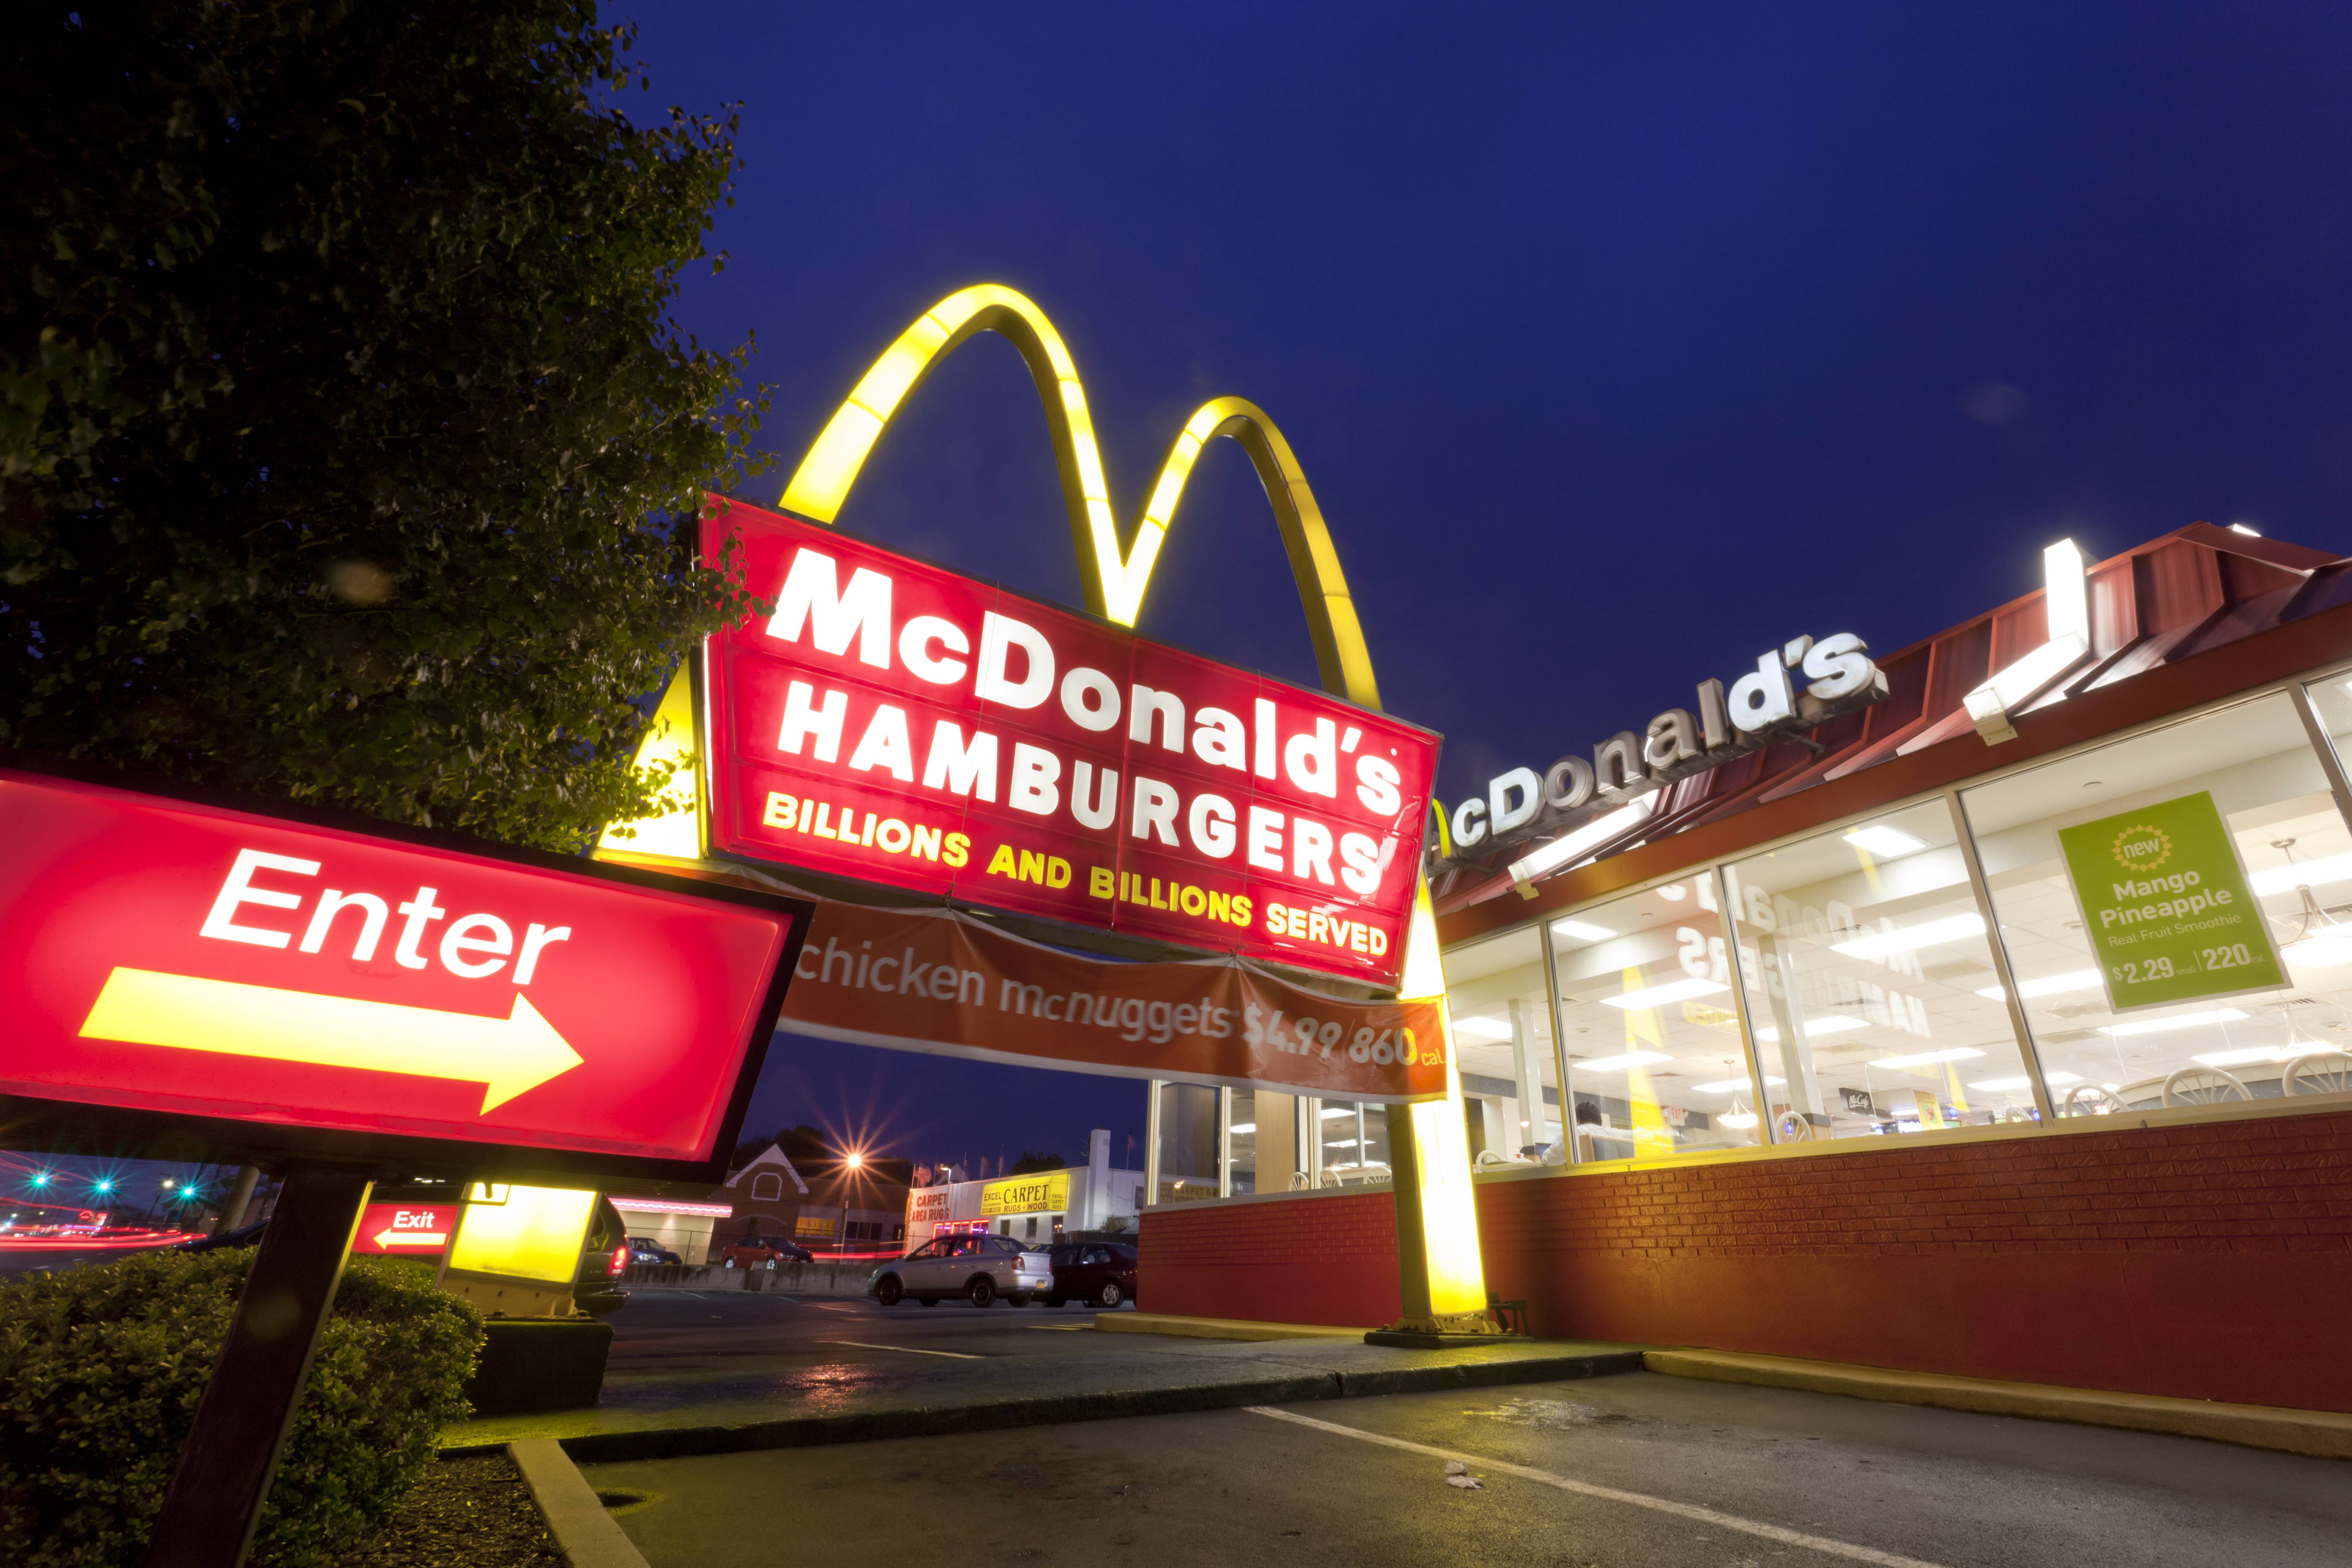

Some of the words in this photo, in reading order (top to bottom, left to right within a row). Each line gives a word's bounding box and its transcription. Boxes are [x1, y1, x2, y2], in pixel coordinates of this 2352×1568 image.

[765, 547, 1401, 817] McDonald's
[1432, 633, 1883, 859] cDonald's
[778, 681, 1381, 895] HAMBURGERS
[2123, 838, 2159, 859] new
[763, 791, 971, 868] BILLIONS
[987, 843, 1072, 890] AND
[1090, 865, 1253, 927] BILLIONS
[1267, 903, 1387, 956] SERVED
[2113, 871, 2200, 901] Mango
[199, 848, 572, 985] Enter
[2100, 889, 2233, 928] Pineapple
[2108, 932, 2138, 946] Real
[2140, 926, 2172, 941] Fruit
[2174, 913, 2241, 934] Smoothie
[2176, 965, 2197, 975] small
[2202, 944, 2251, 971] 220
[795, 937, 985, 1006] chicken
[999, 978, 1232, 1043] mcnuggets
[917, 1193, 948, 1207] CARPET
[984, 1192, 1001, 1201] EXCEL
[1003, 1184, 1049, 1204] CARPET
[1027, 1202, 1047, 1210] WOOD
[393, 1211, 435, 1228] Exit
[911, 1210, 926, 1222] AREA
